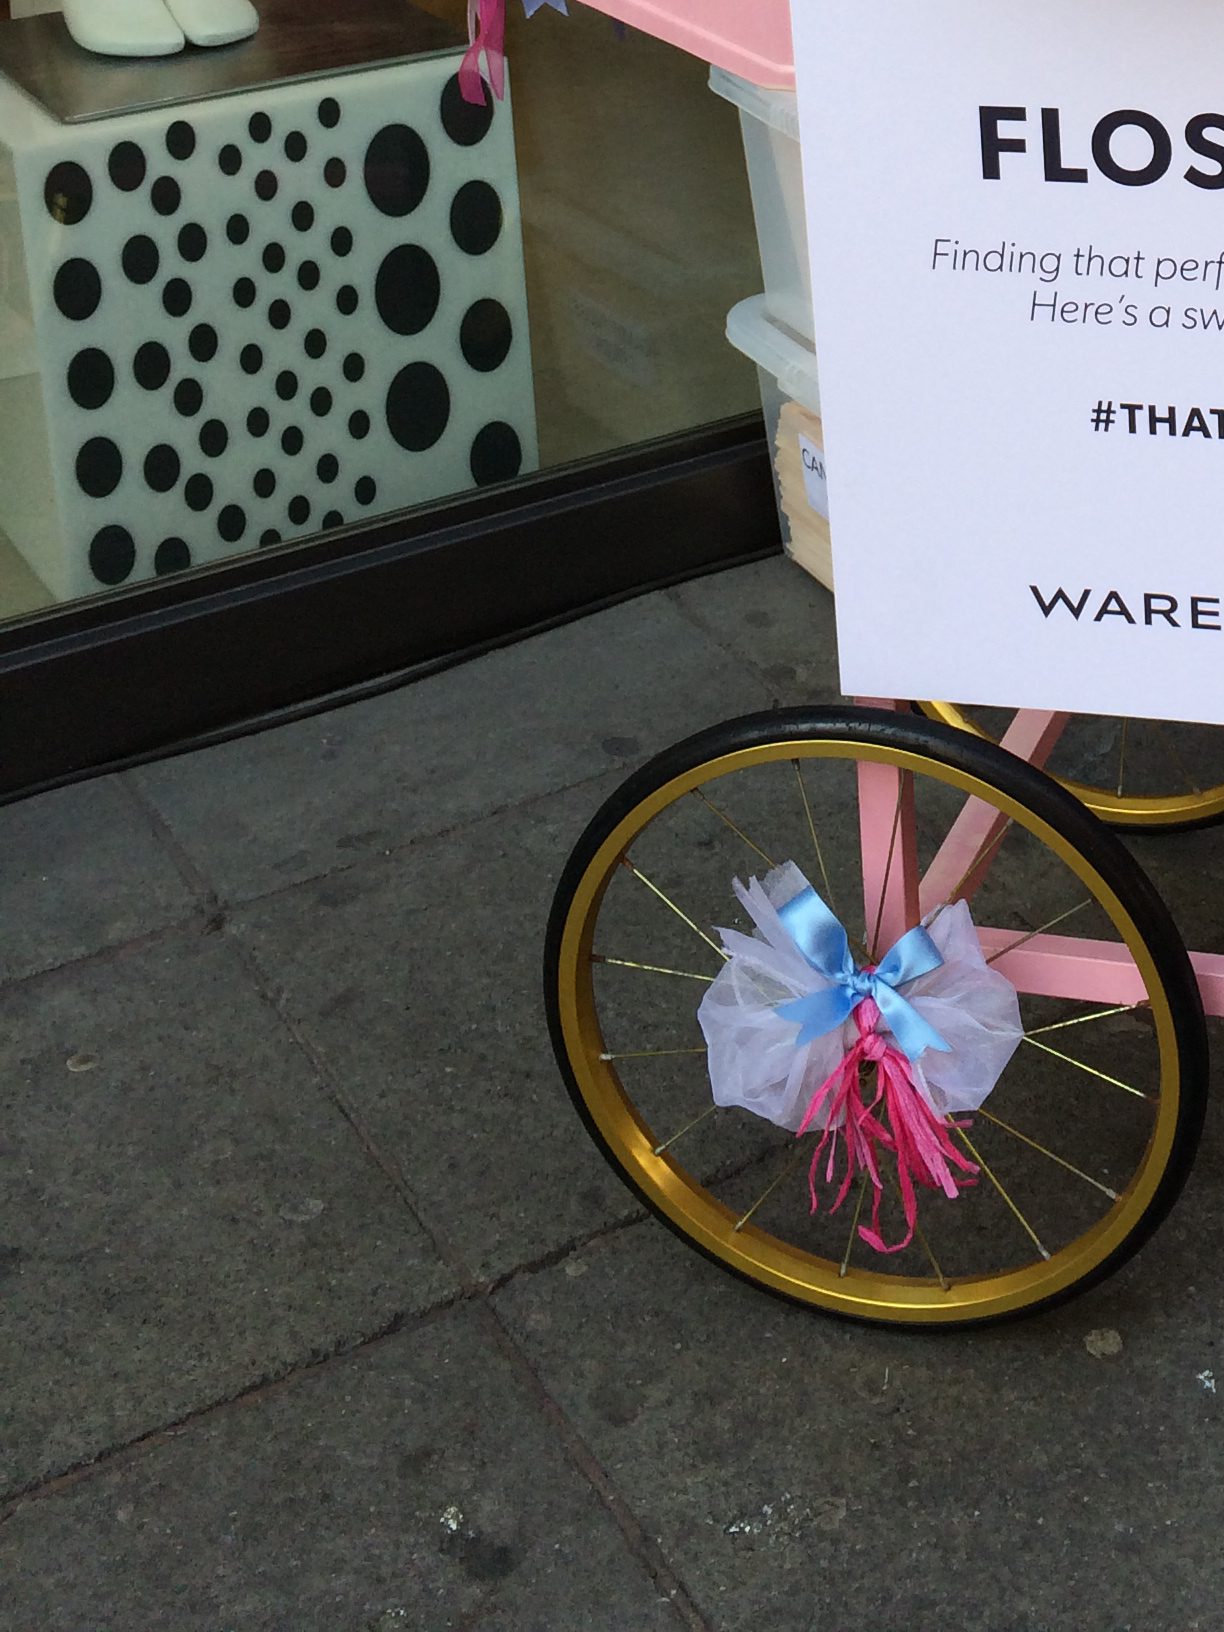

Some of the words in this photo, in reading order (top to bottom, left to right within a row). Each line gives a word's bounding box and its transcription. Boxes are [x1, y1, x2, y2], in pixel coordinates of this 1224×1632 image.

[931, 238, 1062, 283] Finding
[1073, 245, 1146, 279] that
[1030, 291, 1138, 327] Here's
[1148, 305, 1171, 328] a
